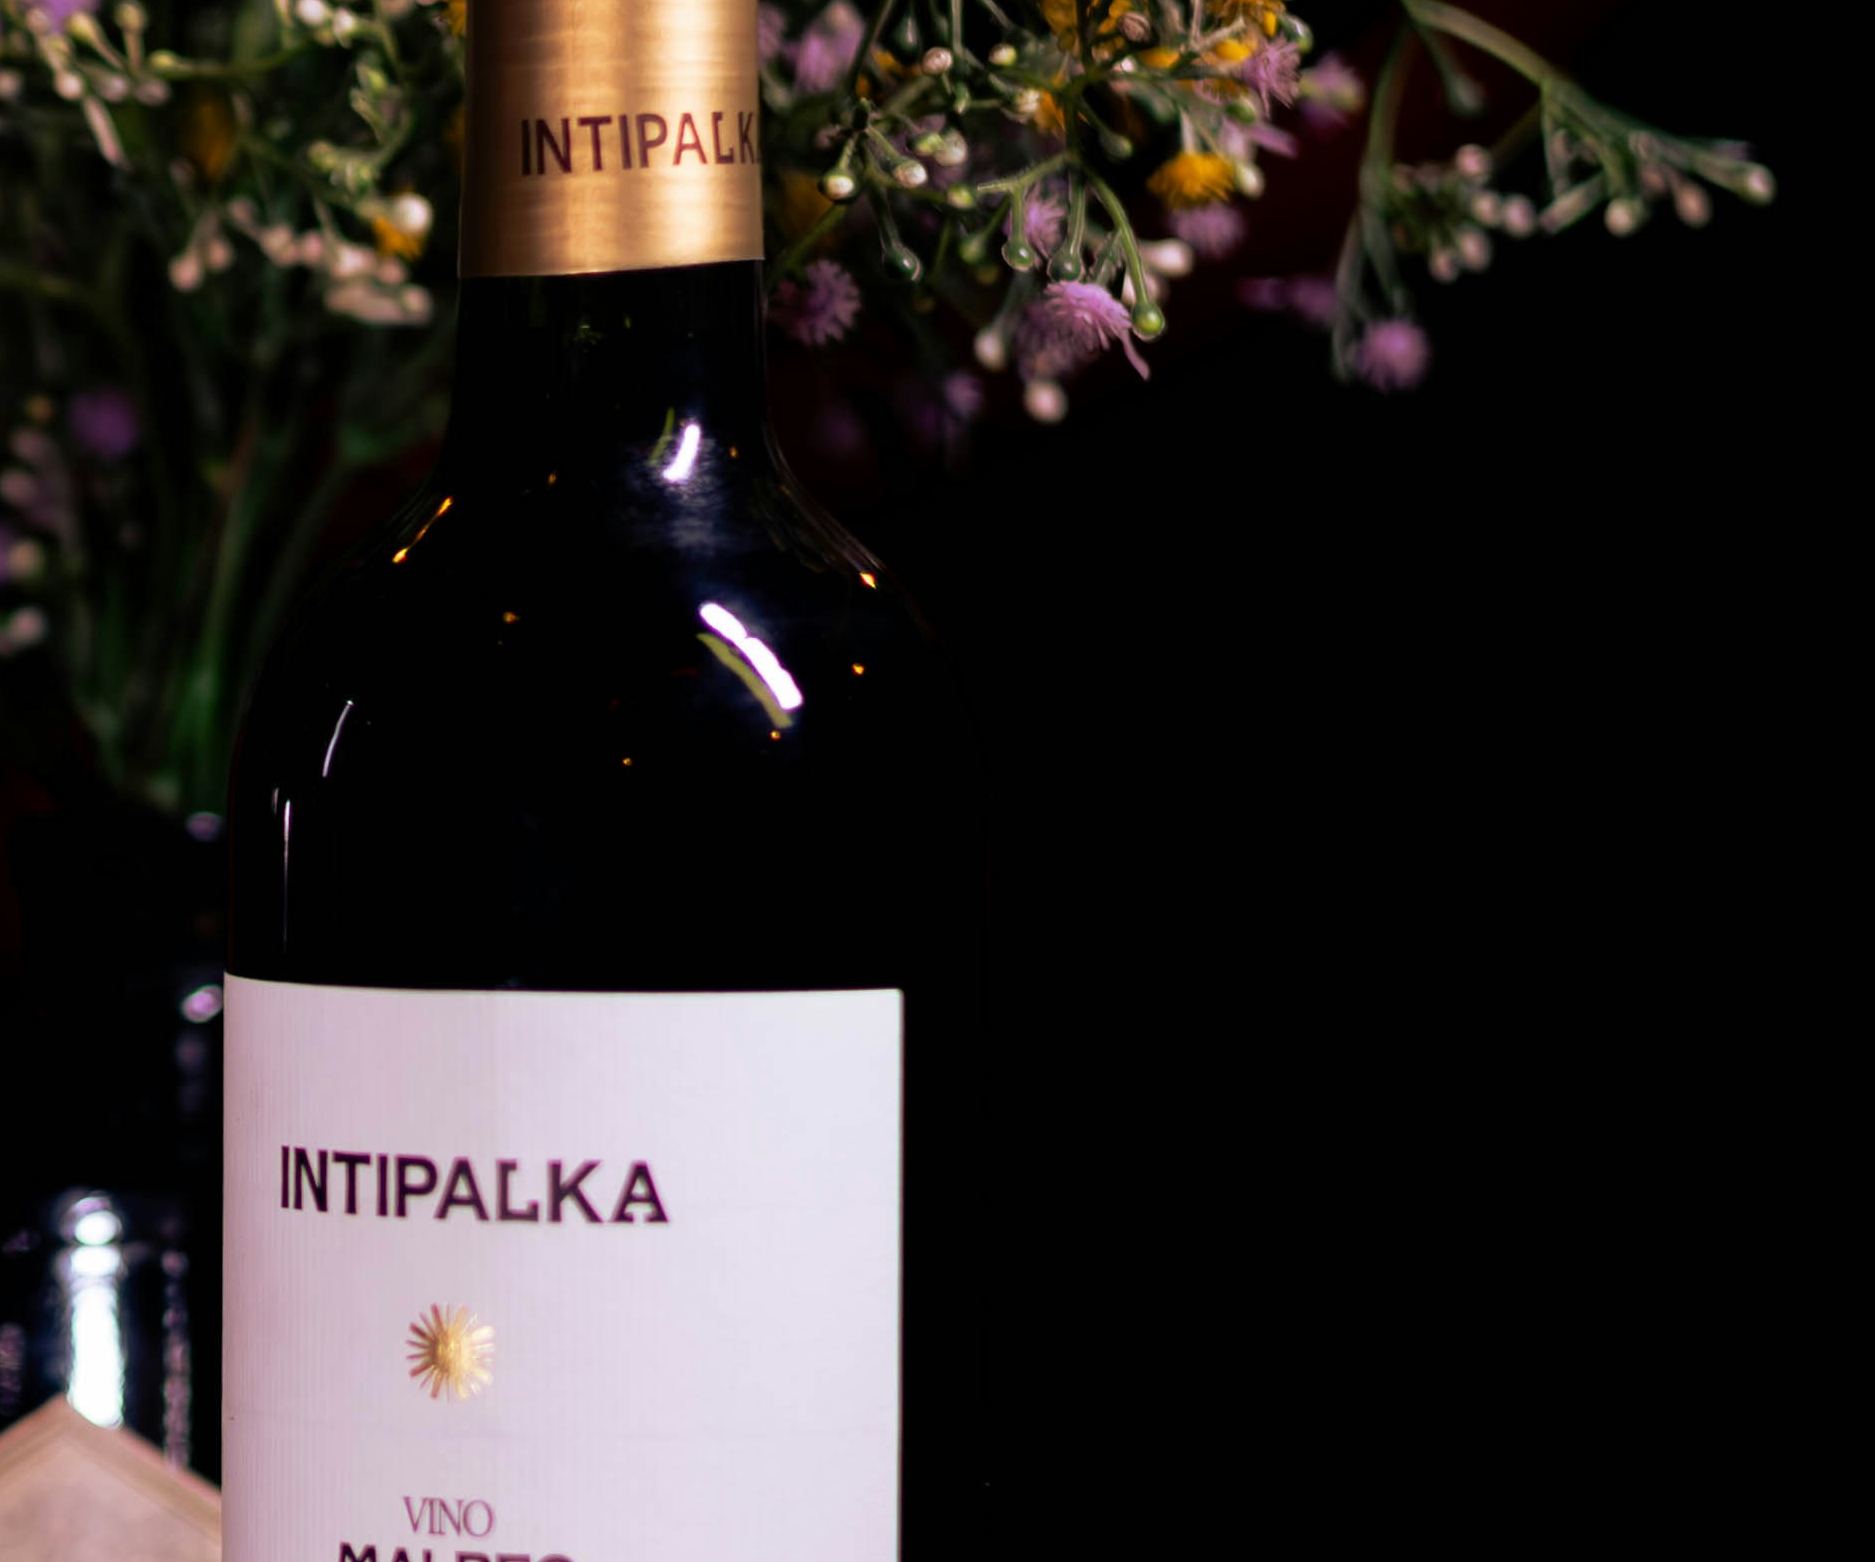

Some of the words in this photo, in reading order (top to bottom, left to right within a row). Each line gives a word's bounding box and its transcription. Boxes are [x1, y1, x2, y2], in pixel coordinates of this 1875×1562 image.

[521, 111, 760, 176] INTIPALK
[280, 1145, 670, 1224] INTIPALKA
[402, 1496, 496, 1538] VINO
